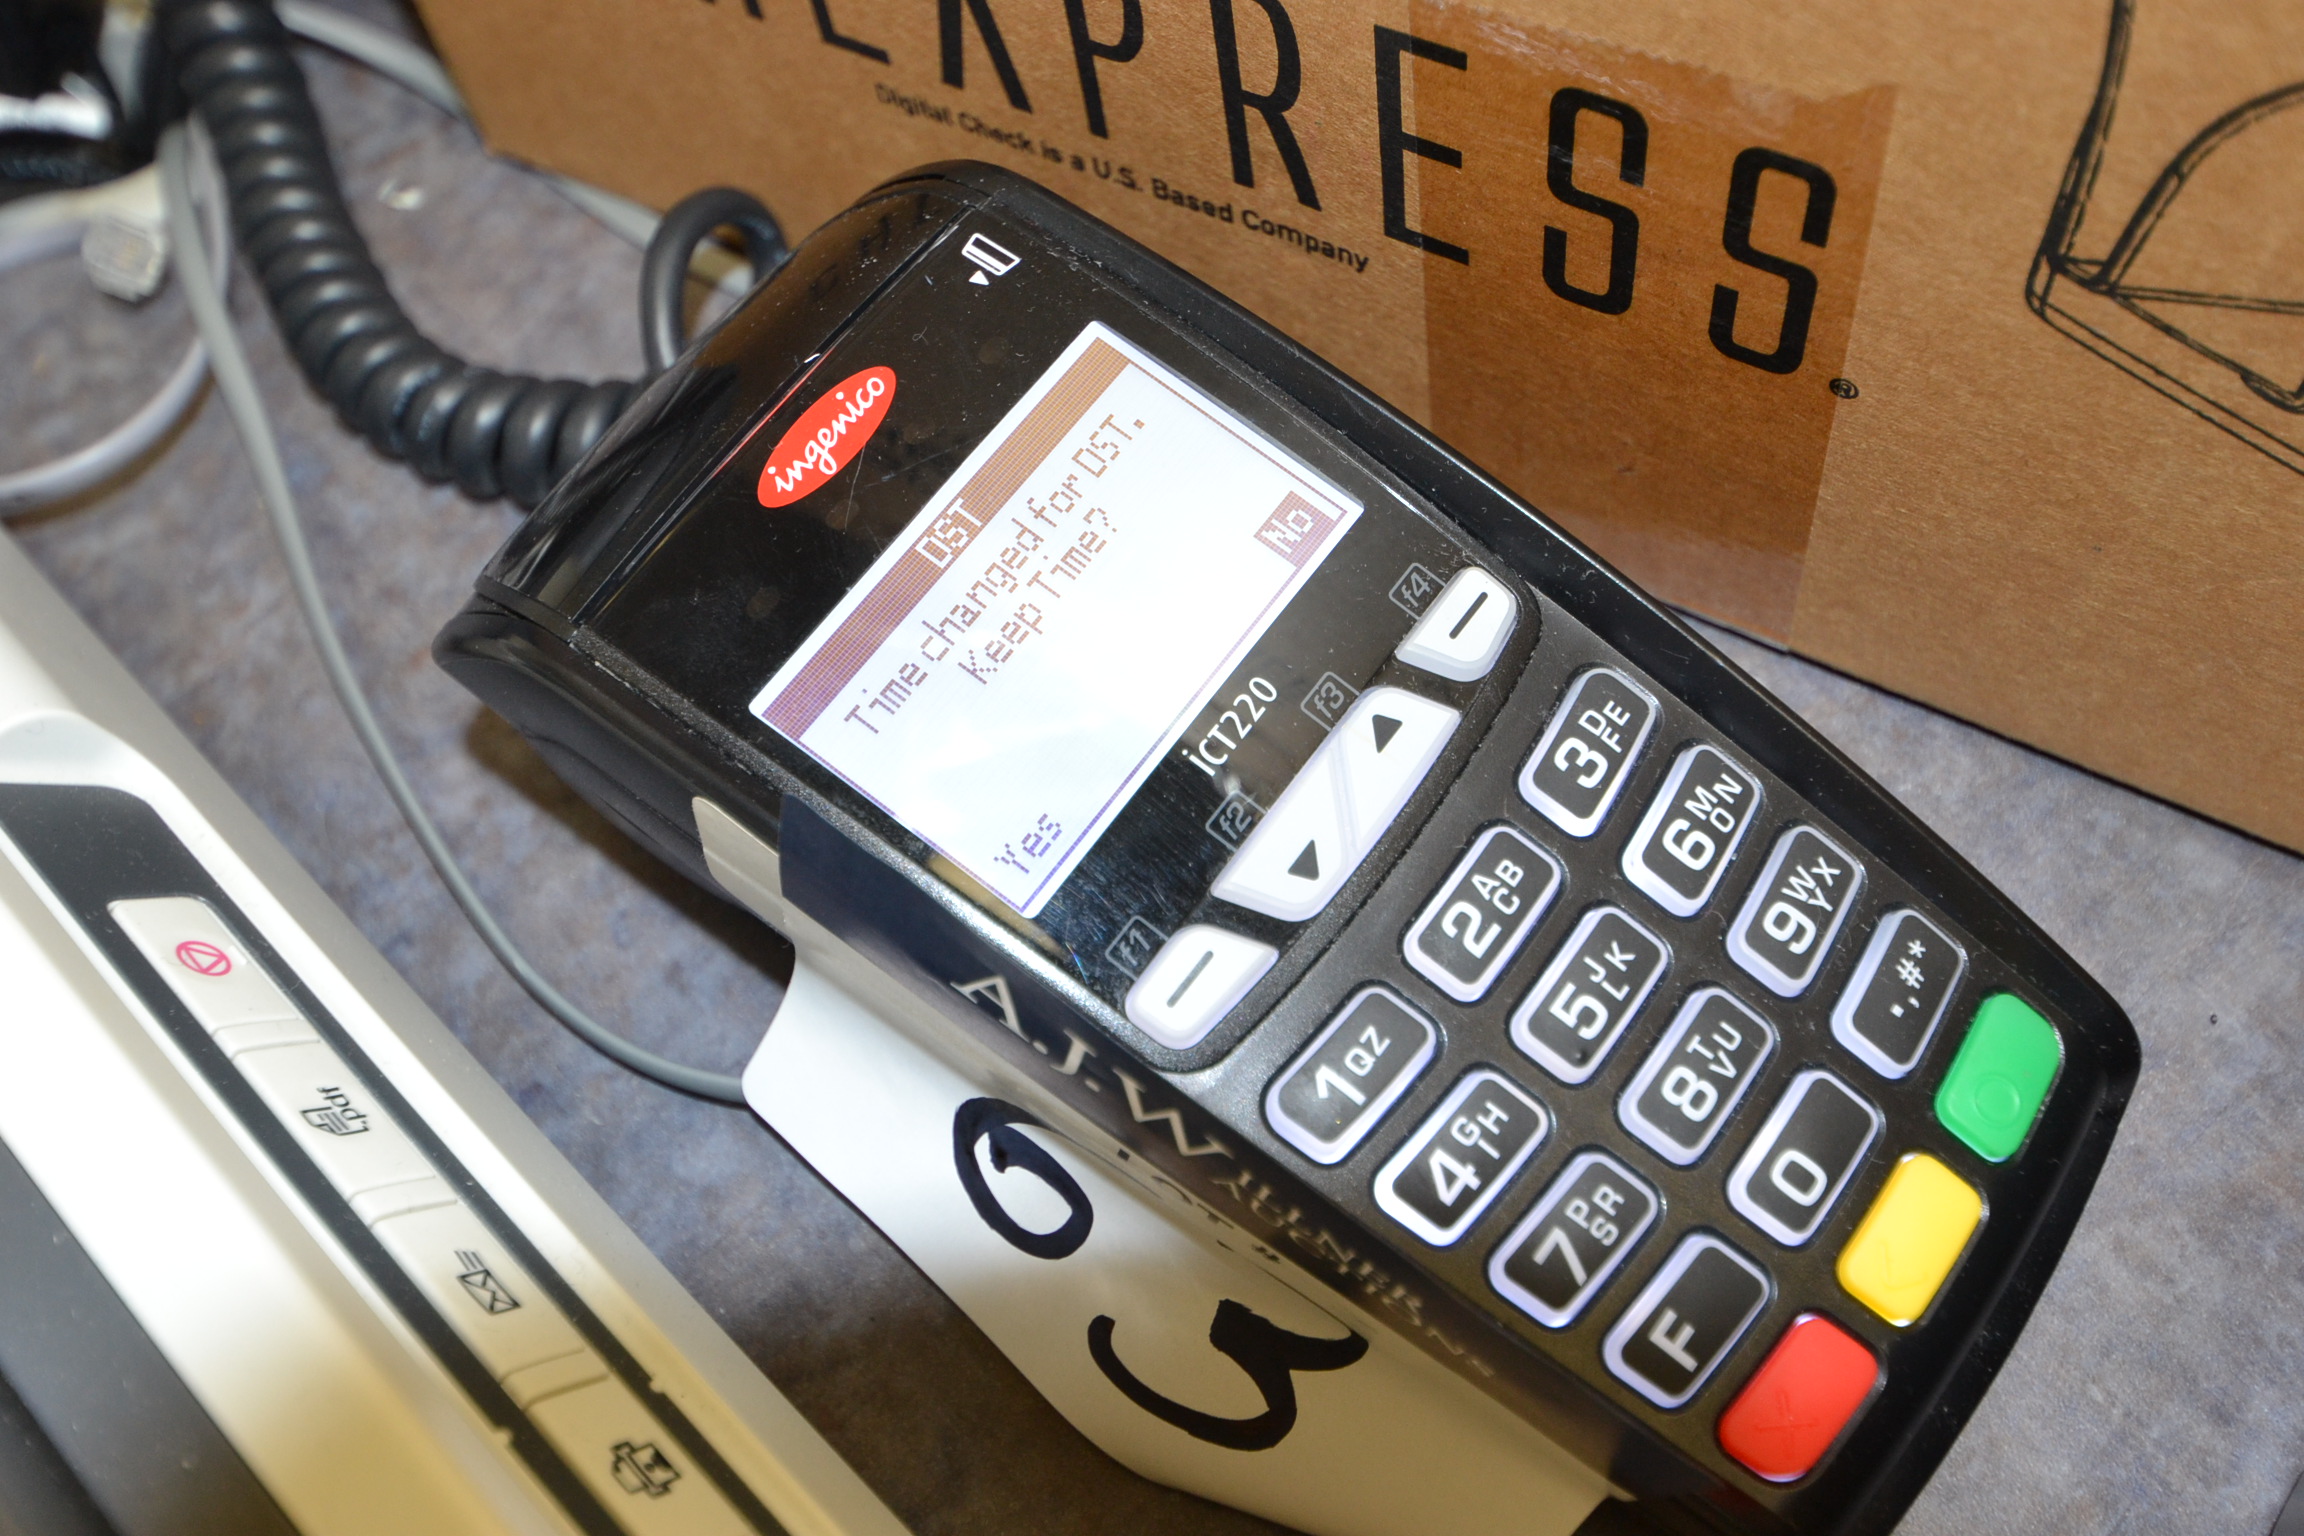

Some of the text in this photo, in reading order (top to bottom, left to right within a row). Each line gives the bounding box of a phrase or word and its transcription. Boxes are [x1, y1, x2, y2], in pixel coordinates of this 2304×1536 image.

[704, 0, 1838, 375] PRESS
[874, 82, 1370, 273] Digital Check is a U.S. Based Company
[768, 376, 886, 494] ingenico
[914, 499, 982, 564] DST
[1259, 507, 1313, 555] No
[844, 657, 929, 735] Time
[921, 516, 1042, 661] changed
[1027, 472, 1081, 528] for
[958, 506, 1119, 685] Keep Time?
[1401, 572, 1432, 610] f4
[1180, 676, 1278, 777] iCT220
[1313, 680, 1347, 718] f3
[1553, 738, 1608, 789] 3
[993, 812, 1064, 875] Yes
[1220, 798, 1252, 840] f2
[1663, 818, 1715, 872] 6
[1442, 901, 1500, 959] 2
[1762, 902, 1817, 955] 9
[1548, 983, 1608, 1041] 5
[1316, 1026, 1391, 1109] 1 QZ
[1660, 1064, 1718, 1122] 8
[1428, 1147, 1482, 1207] 4
[1533, 1228, 1588, 1287] 7
[1648, 1310, 1701, 1373] F
